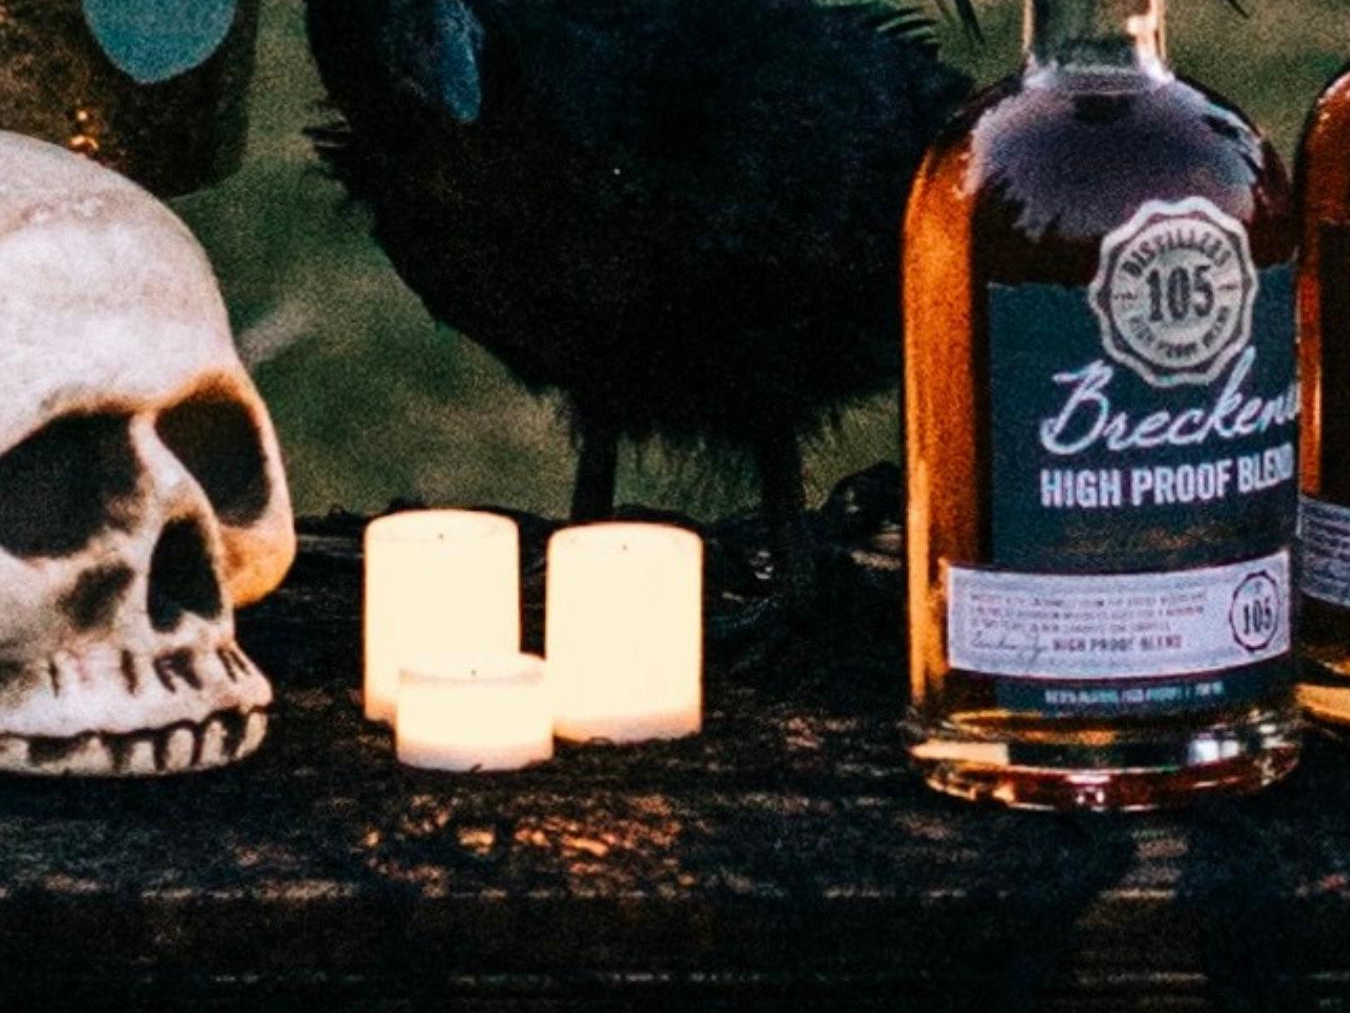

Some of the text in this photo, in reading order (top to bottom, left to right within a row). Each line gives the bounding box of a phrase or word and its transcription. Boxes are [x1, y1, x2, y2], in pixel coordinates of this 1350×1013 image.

[1146, 265, 1214, 322] 105
[1040, 468, 1122, 508] HIGH
[1130, 459, 1232, 507] PROOF
[1243, 597, 1273, 636] 105
